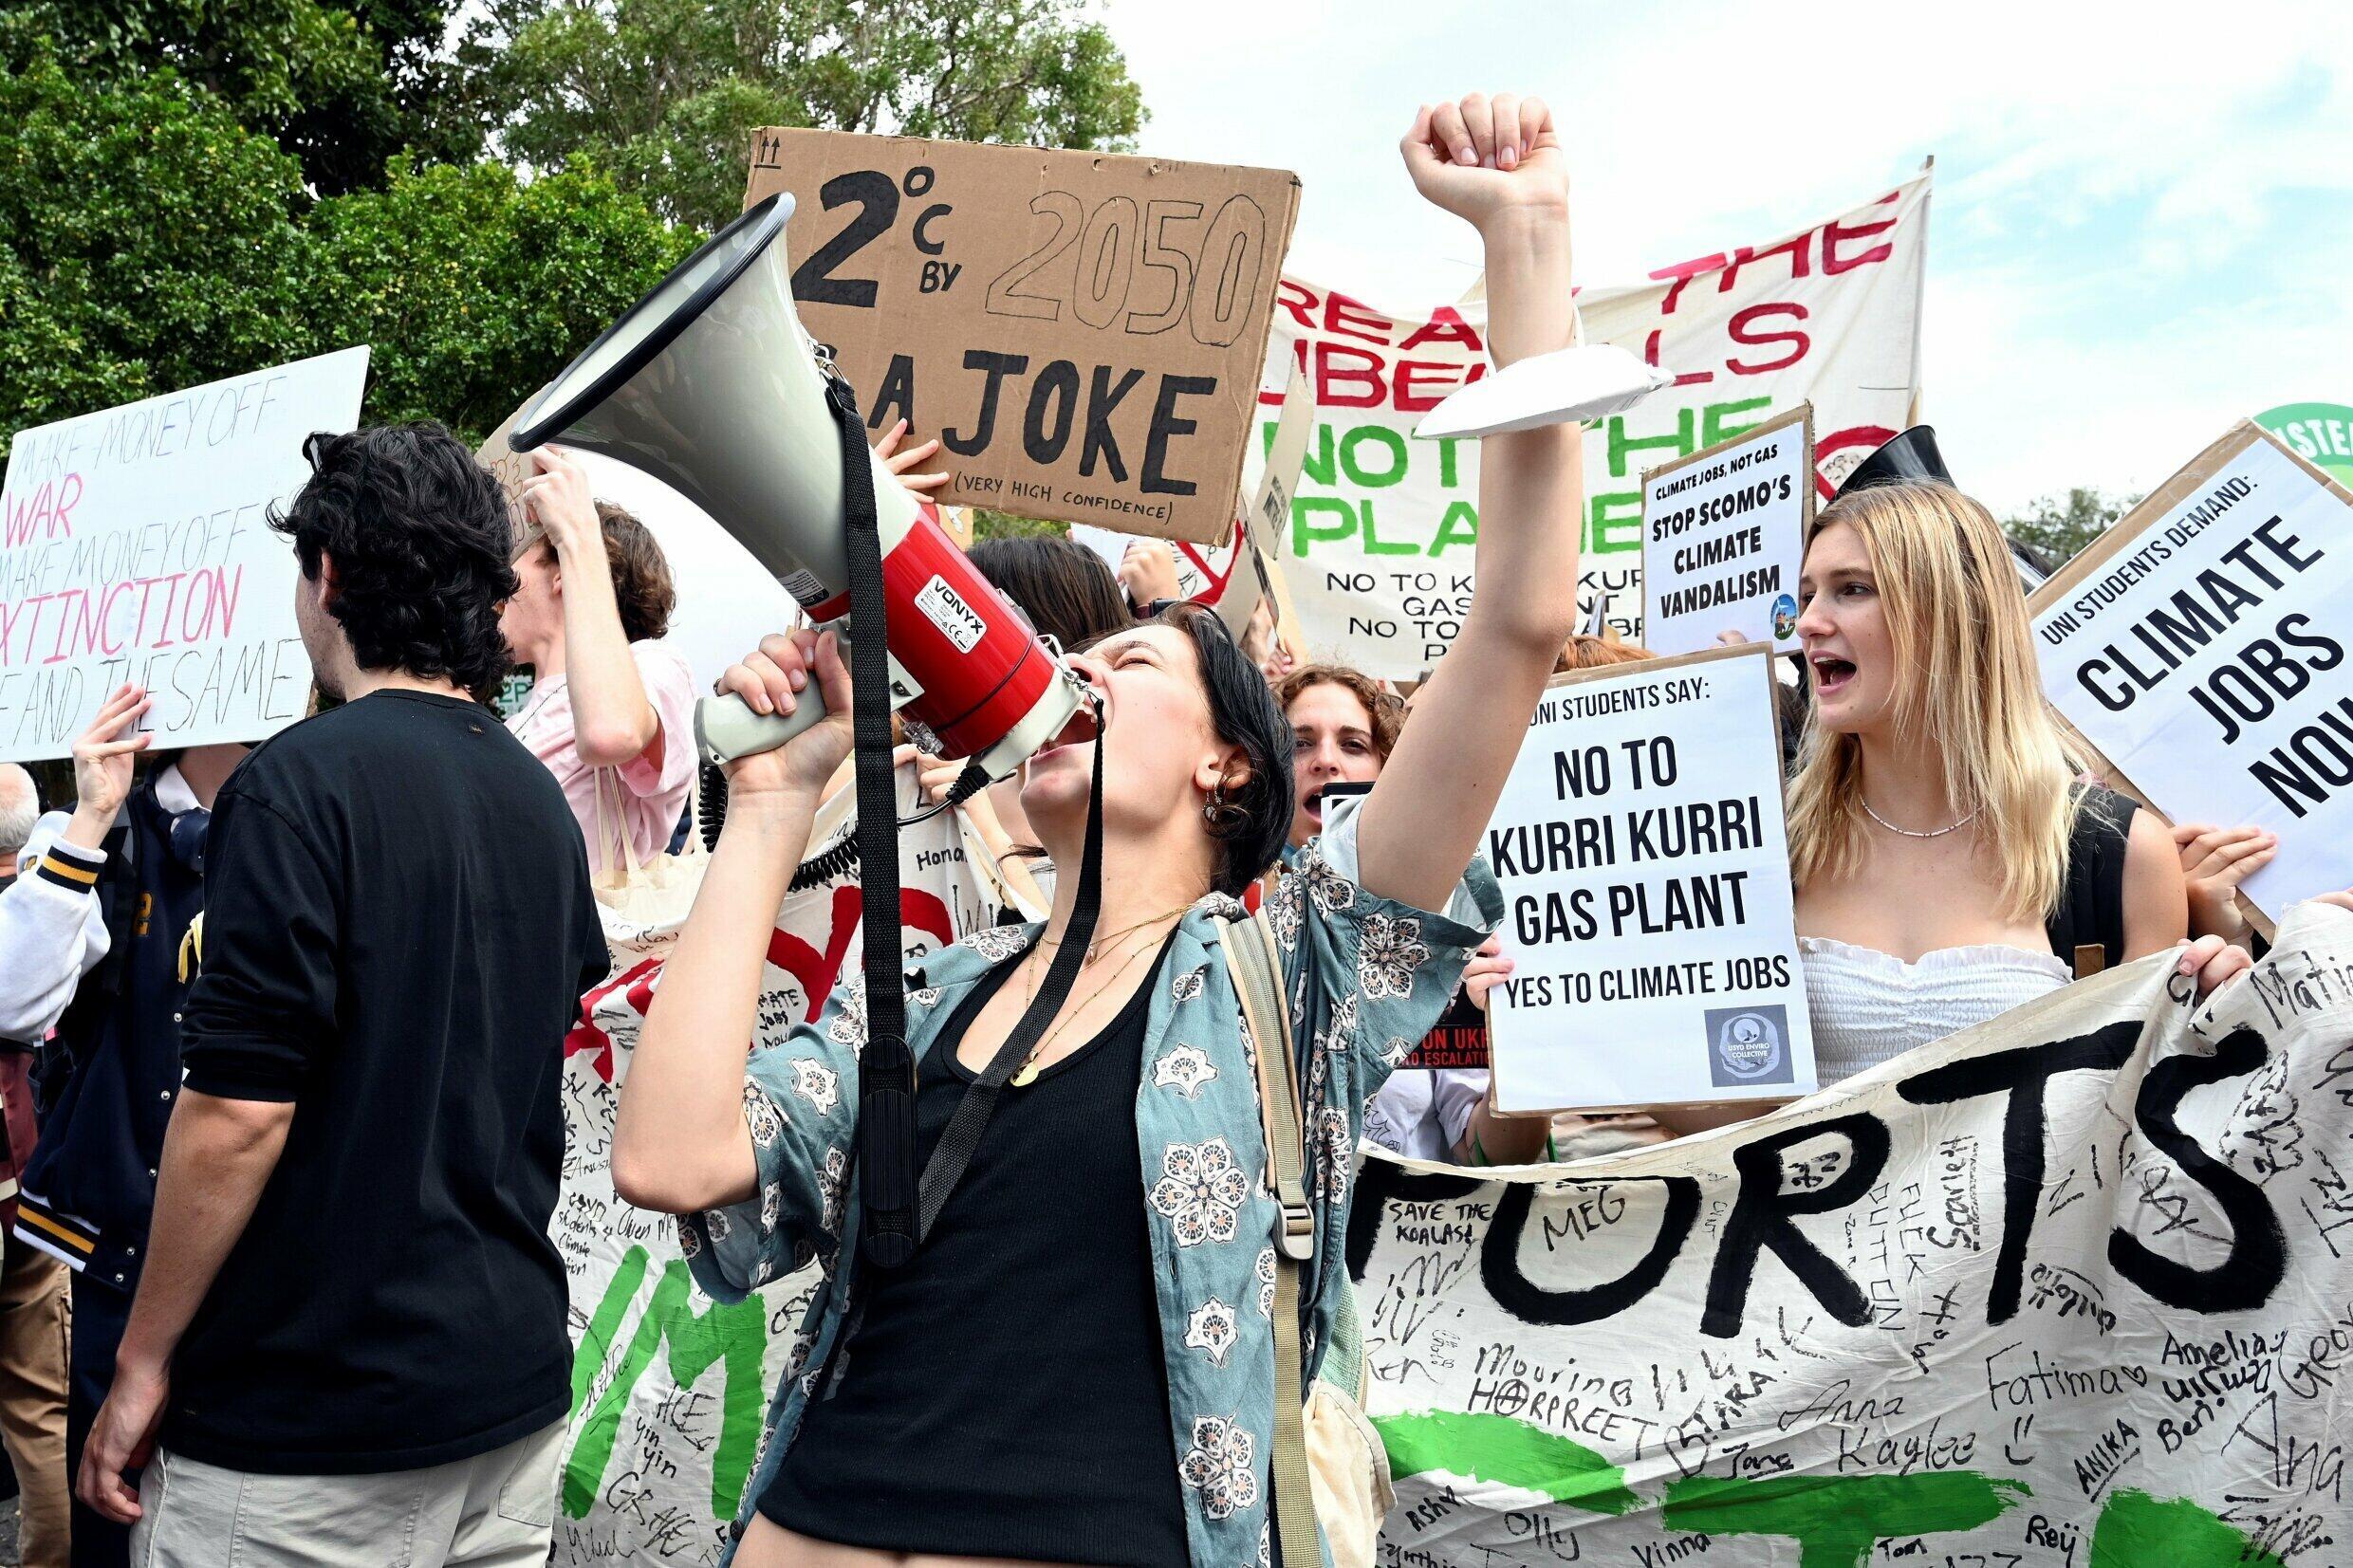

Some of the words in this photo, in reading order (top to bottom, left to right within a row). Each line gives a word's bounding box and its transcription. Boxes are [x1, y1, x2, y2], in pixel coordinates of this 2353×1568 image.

[918, 260, 962, 294] BY
[984, 190, 1266, 348] 2050
[1276, 280, 1484, 351] REA
[93, 393, 207, 470] MONEY
[207, 375, 287, 448] OFF
[866, 354, 916, 435] A
[941, 348, 1218, 497] JOKE
[1581, 397, 1772, 478] HE
[954, 470, 1004, 494] (VERY
[1010, 480, 1052, 503] HIGH
[1062, 490, 1174, 526] CONFIDENCE)
[1656, 472, 1697, 502] CLIMATE
[1698, 464, 1728, 487] JOBS,
[1730, 452, 1753, 474] NOT
[1754, 443, 1779, 464] GAS
[6, 472, 83, 549] WAR
[1652, 507, 1696, 544] STOP
[63, 518, 180, 593] MONEY
[181, 503, 260, 572] OFF
[1326, 571, 1377, 592] NO
[1389, 572, 1437, 592] TO
[1673, 525, 1763, 576] CLIMATE
[2040, 608, 2082, 646] UNI
[2073, 540, 2173, 621] STUDENTS
[2164, 474, 2259, 549] DEMAND:
[0, 563, 243, 667] XTINCTION
[934, 578, 984, 636] VONYX
[1402, 596, 1473, 617] GAS
[1659, 563, 1782, 619] VANDALISM
[2076, 513, 2326, 713] CLIMATE
[1348, 617, 1398, 638] NO
[1412, 619, 1461, 640] TO
[12, 665, 84, 749] AND
[165, 636, 304, 733] SAME
[1562, 684, 1660, 721] STUDENTS
[1663, 675, 1712, 704] SAY:
[2187, 612, 2345, 747] JOBS
[1553, 744, 1612, 802] NO
[1621, 734, 1678, 791] TO
[1489, 814, 1616, 878] KURRI
[1627, 795, 1764, 863] KURRI
[1514, 887, 1599, 947] GAS
[1607, 870, 1749, 938] PLANT
[1504, 973, 1553, 1009] YES
[1558, 970, 1593, 1005] TO
[1599, 960, 1716, 1002] CLIMATE
[1723, 953, 1792, 992] JOBS
[1732, 1050, 1769, 1059] COLLECTIVE
[1388, 1202, 1446, 1224] SAVE
[1454, 1202, 1493, 1222] THE
[1985, 1340, 2123, 1411] Fatima
[1838, 1416, 1977, 1478] Kaylee
